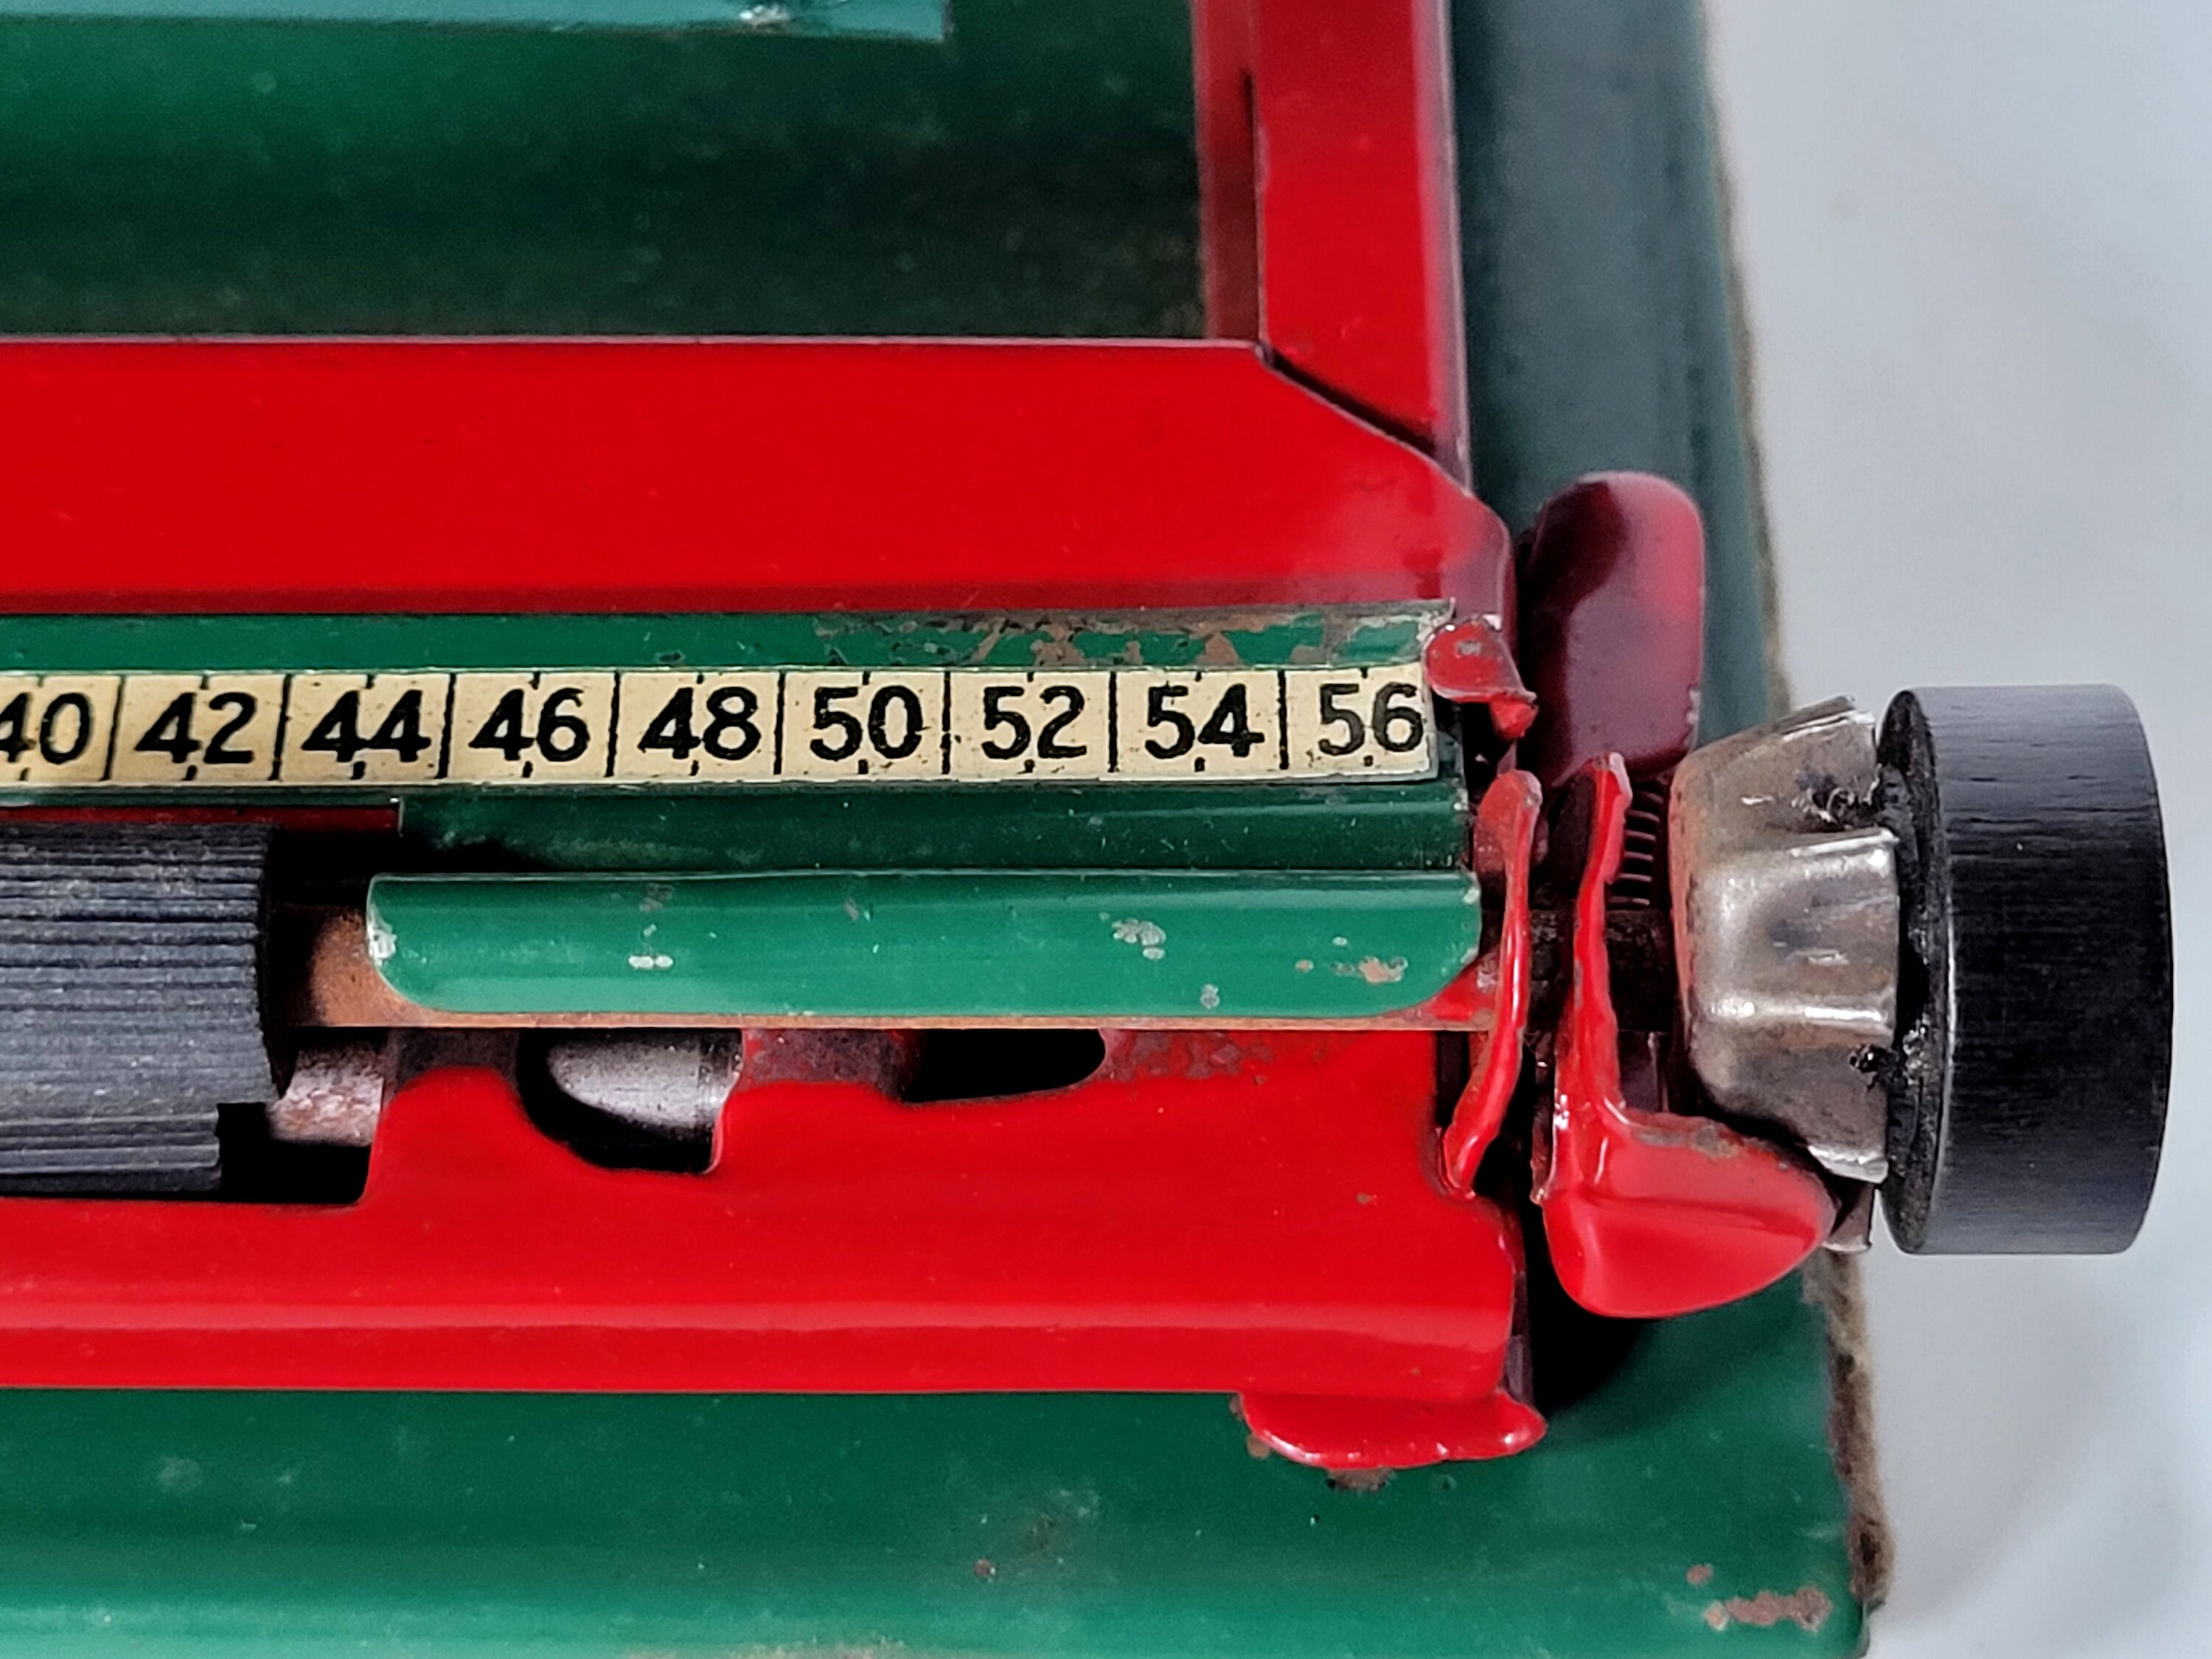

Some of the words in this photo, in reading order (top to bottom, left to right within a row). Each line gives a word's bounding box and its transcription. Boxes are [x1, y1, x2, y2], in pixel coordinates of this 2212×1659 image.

[133, 692, 257, 765] 42
[301, 689, 432, 763] 44
[468, 687, 591, 762] 46
[637, 686, 762, 761] 48
[810, 685, 925, 762] 50
[981, 686, 1088, 760] 52
[1144, 683, 1265, 759] 54
[1318, 682, 1424, 757] 56
